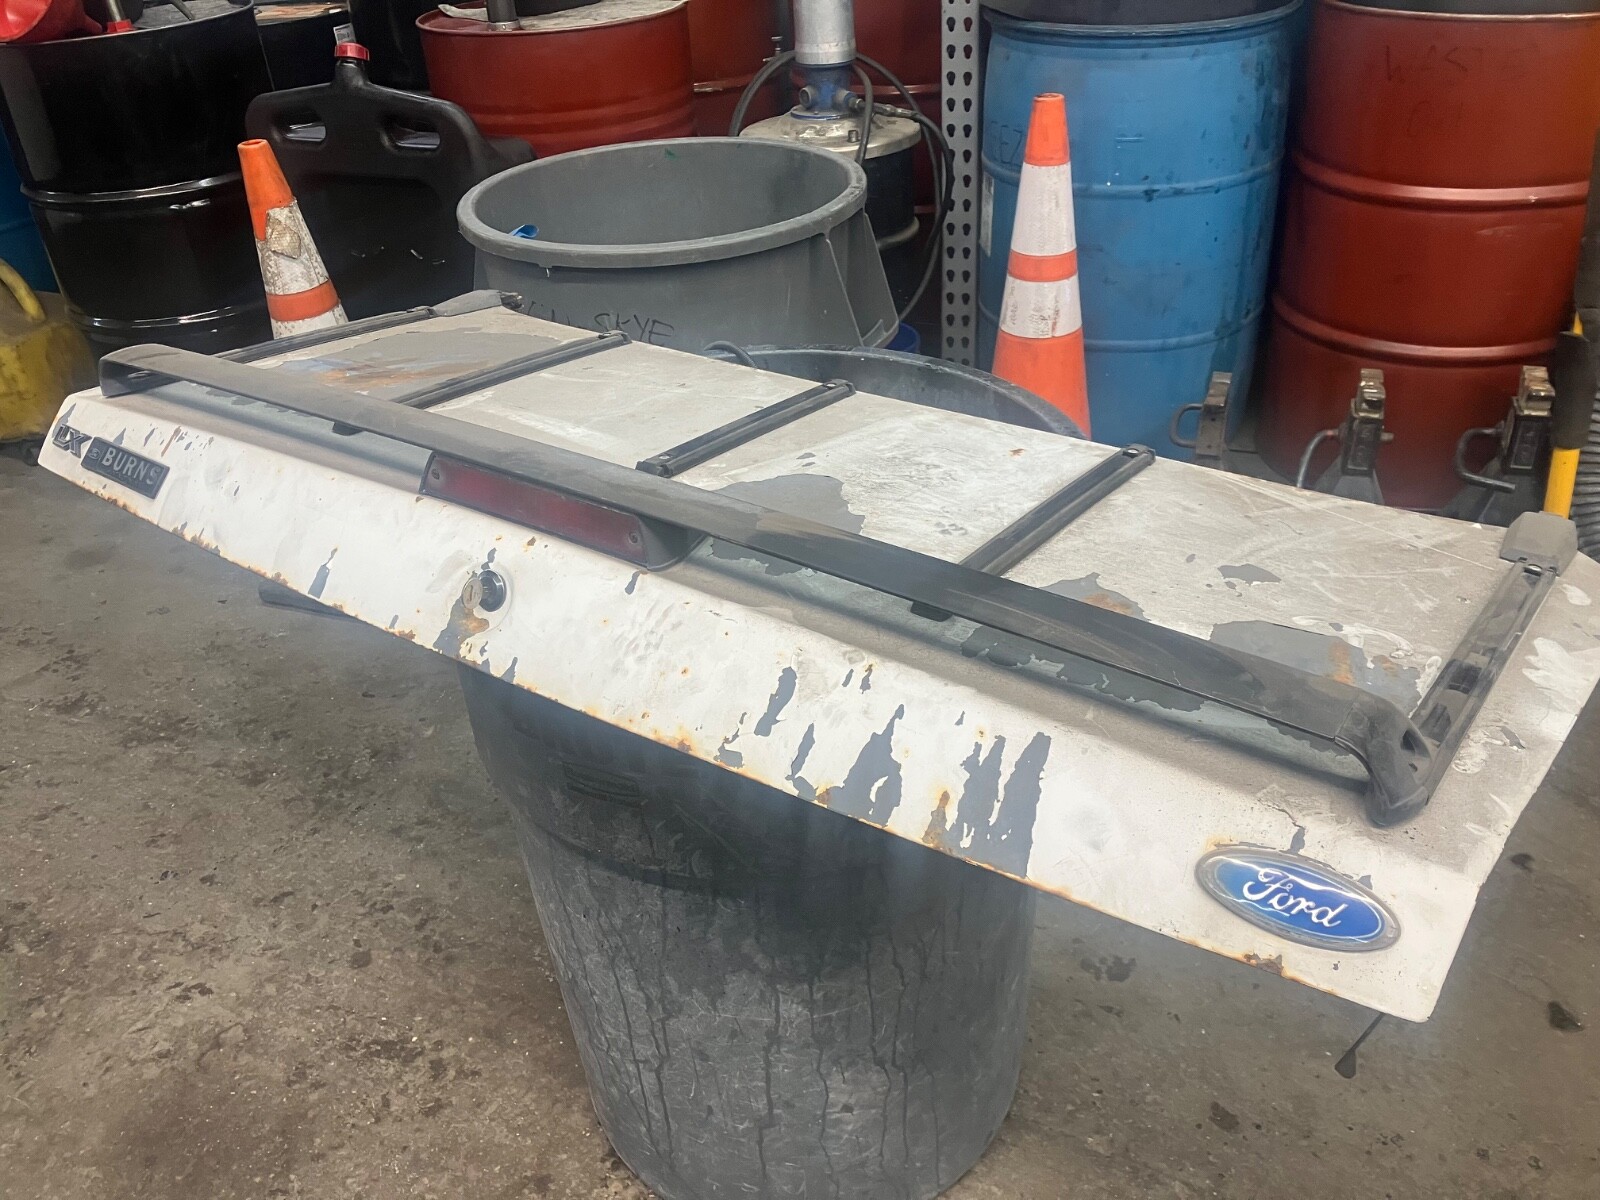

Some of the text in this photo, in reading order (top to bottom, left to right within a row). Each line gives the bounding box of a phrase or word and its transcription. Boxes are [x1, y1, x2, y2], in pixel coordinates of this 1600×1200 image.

[53, 424, 92, 458] LX
[102, 447, 161, 485] BURNS
[1242, 867, 1349, 928] Ford
